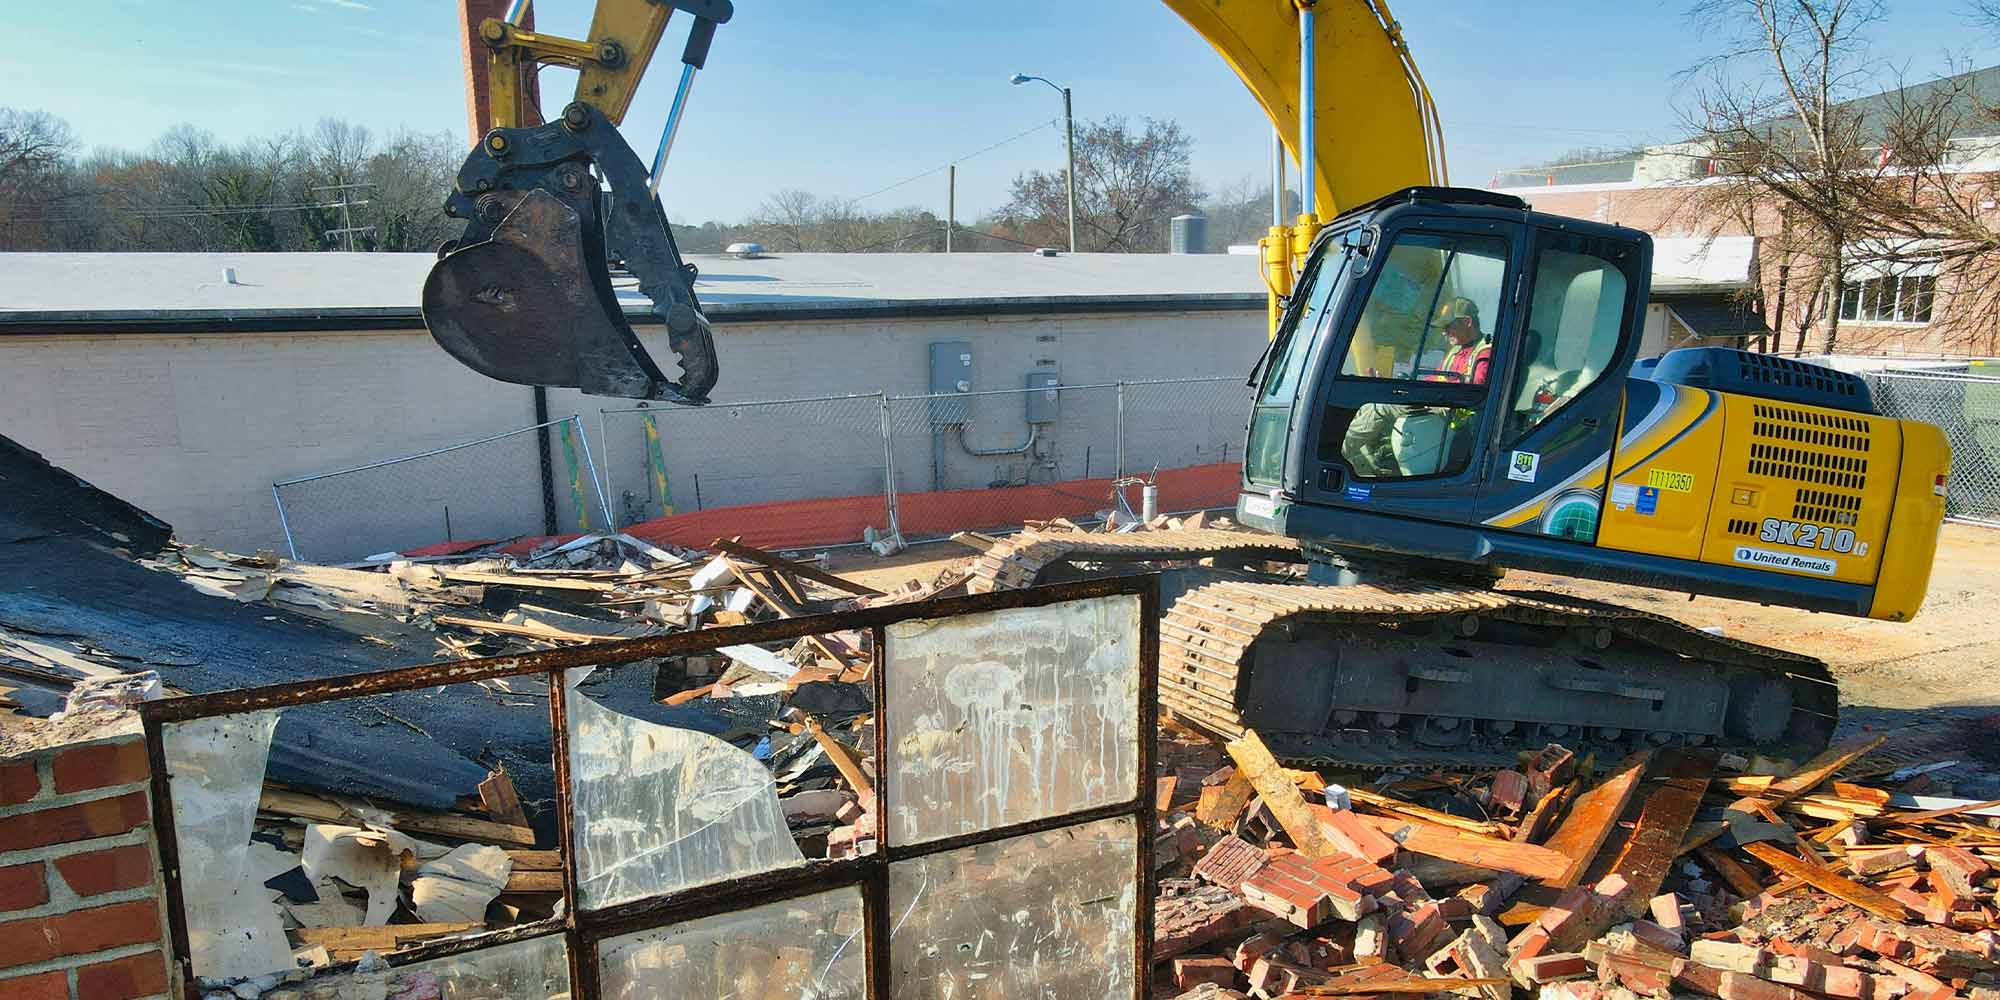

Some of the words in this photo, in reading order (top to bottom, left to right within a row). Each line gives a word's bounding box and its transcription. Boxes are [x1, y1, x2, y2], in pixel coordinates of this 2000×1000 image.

[1516, 453, 1533, 466] 811
[1760, 518, 1855, 553] SK210
[1753, 552, 1790, 566] United
[1791, 558, 1831, 571] Rentals
